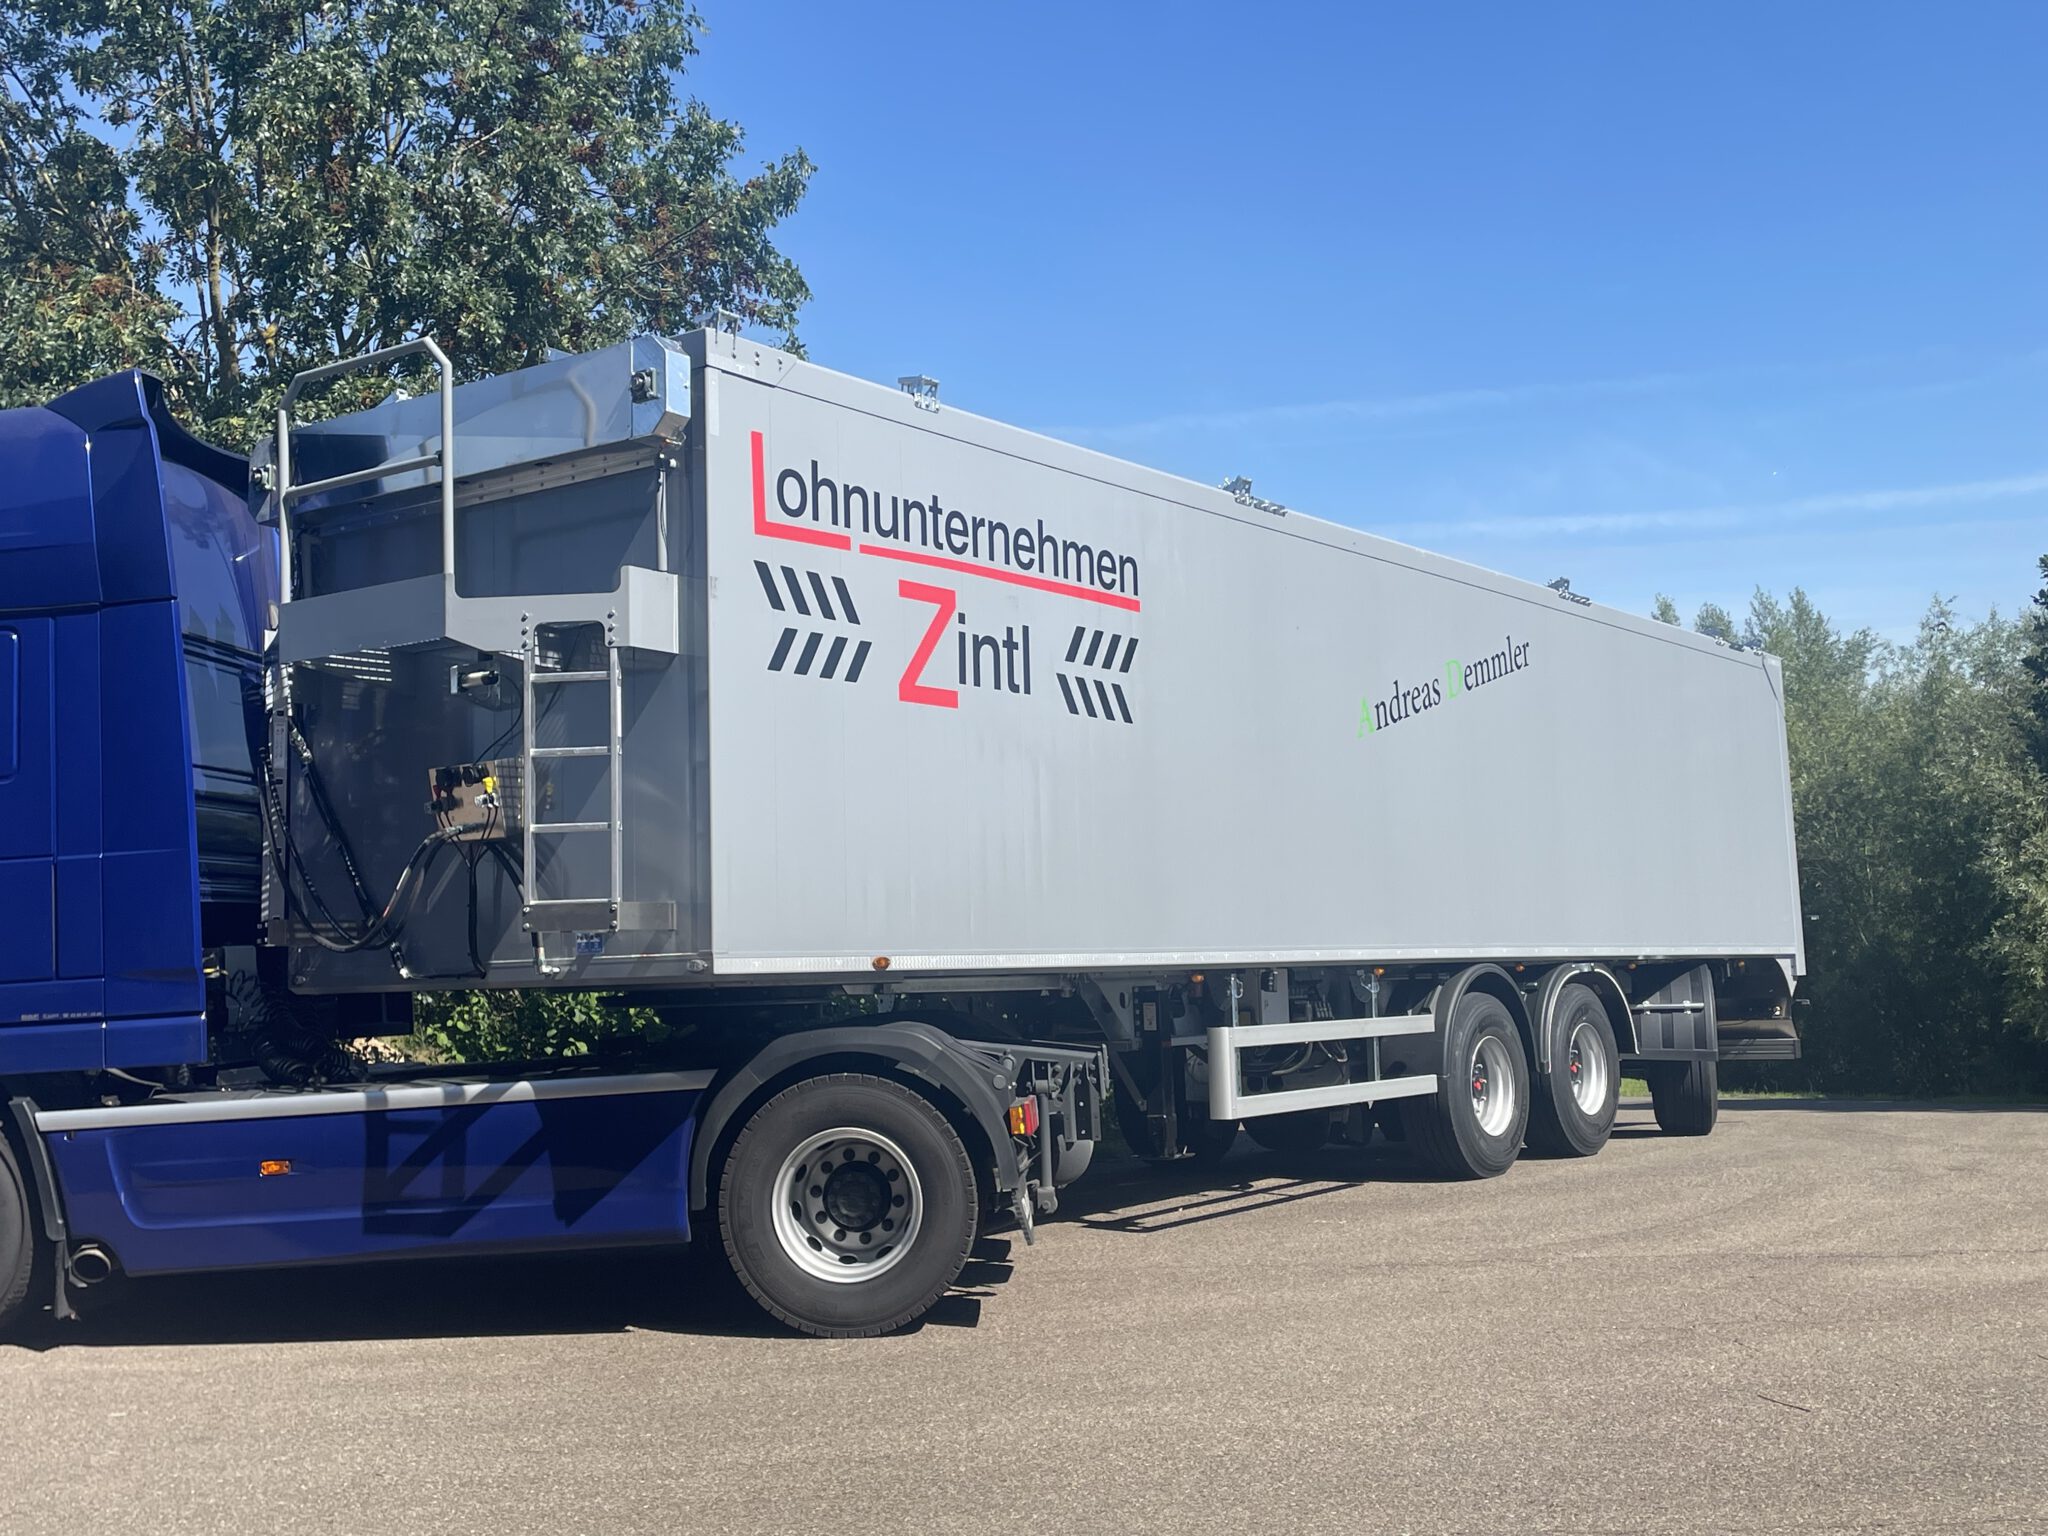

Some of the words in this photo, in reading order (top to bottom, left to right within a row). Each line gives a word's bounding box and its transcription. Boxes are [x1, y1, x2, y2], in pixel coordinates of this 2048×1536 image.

[750, 431, 1139, 597] Lohnunternehmen
[898, 579, 1031, 709] Zintl
[1357, 679, 1441, 738] Andreas
[1445, 635, 1530, 700] Demmler
